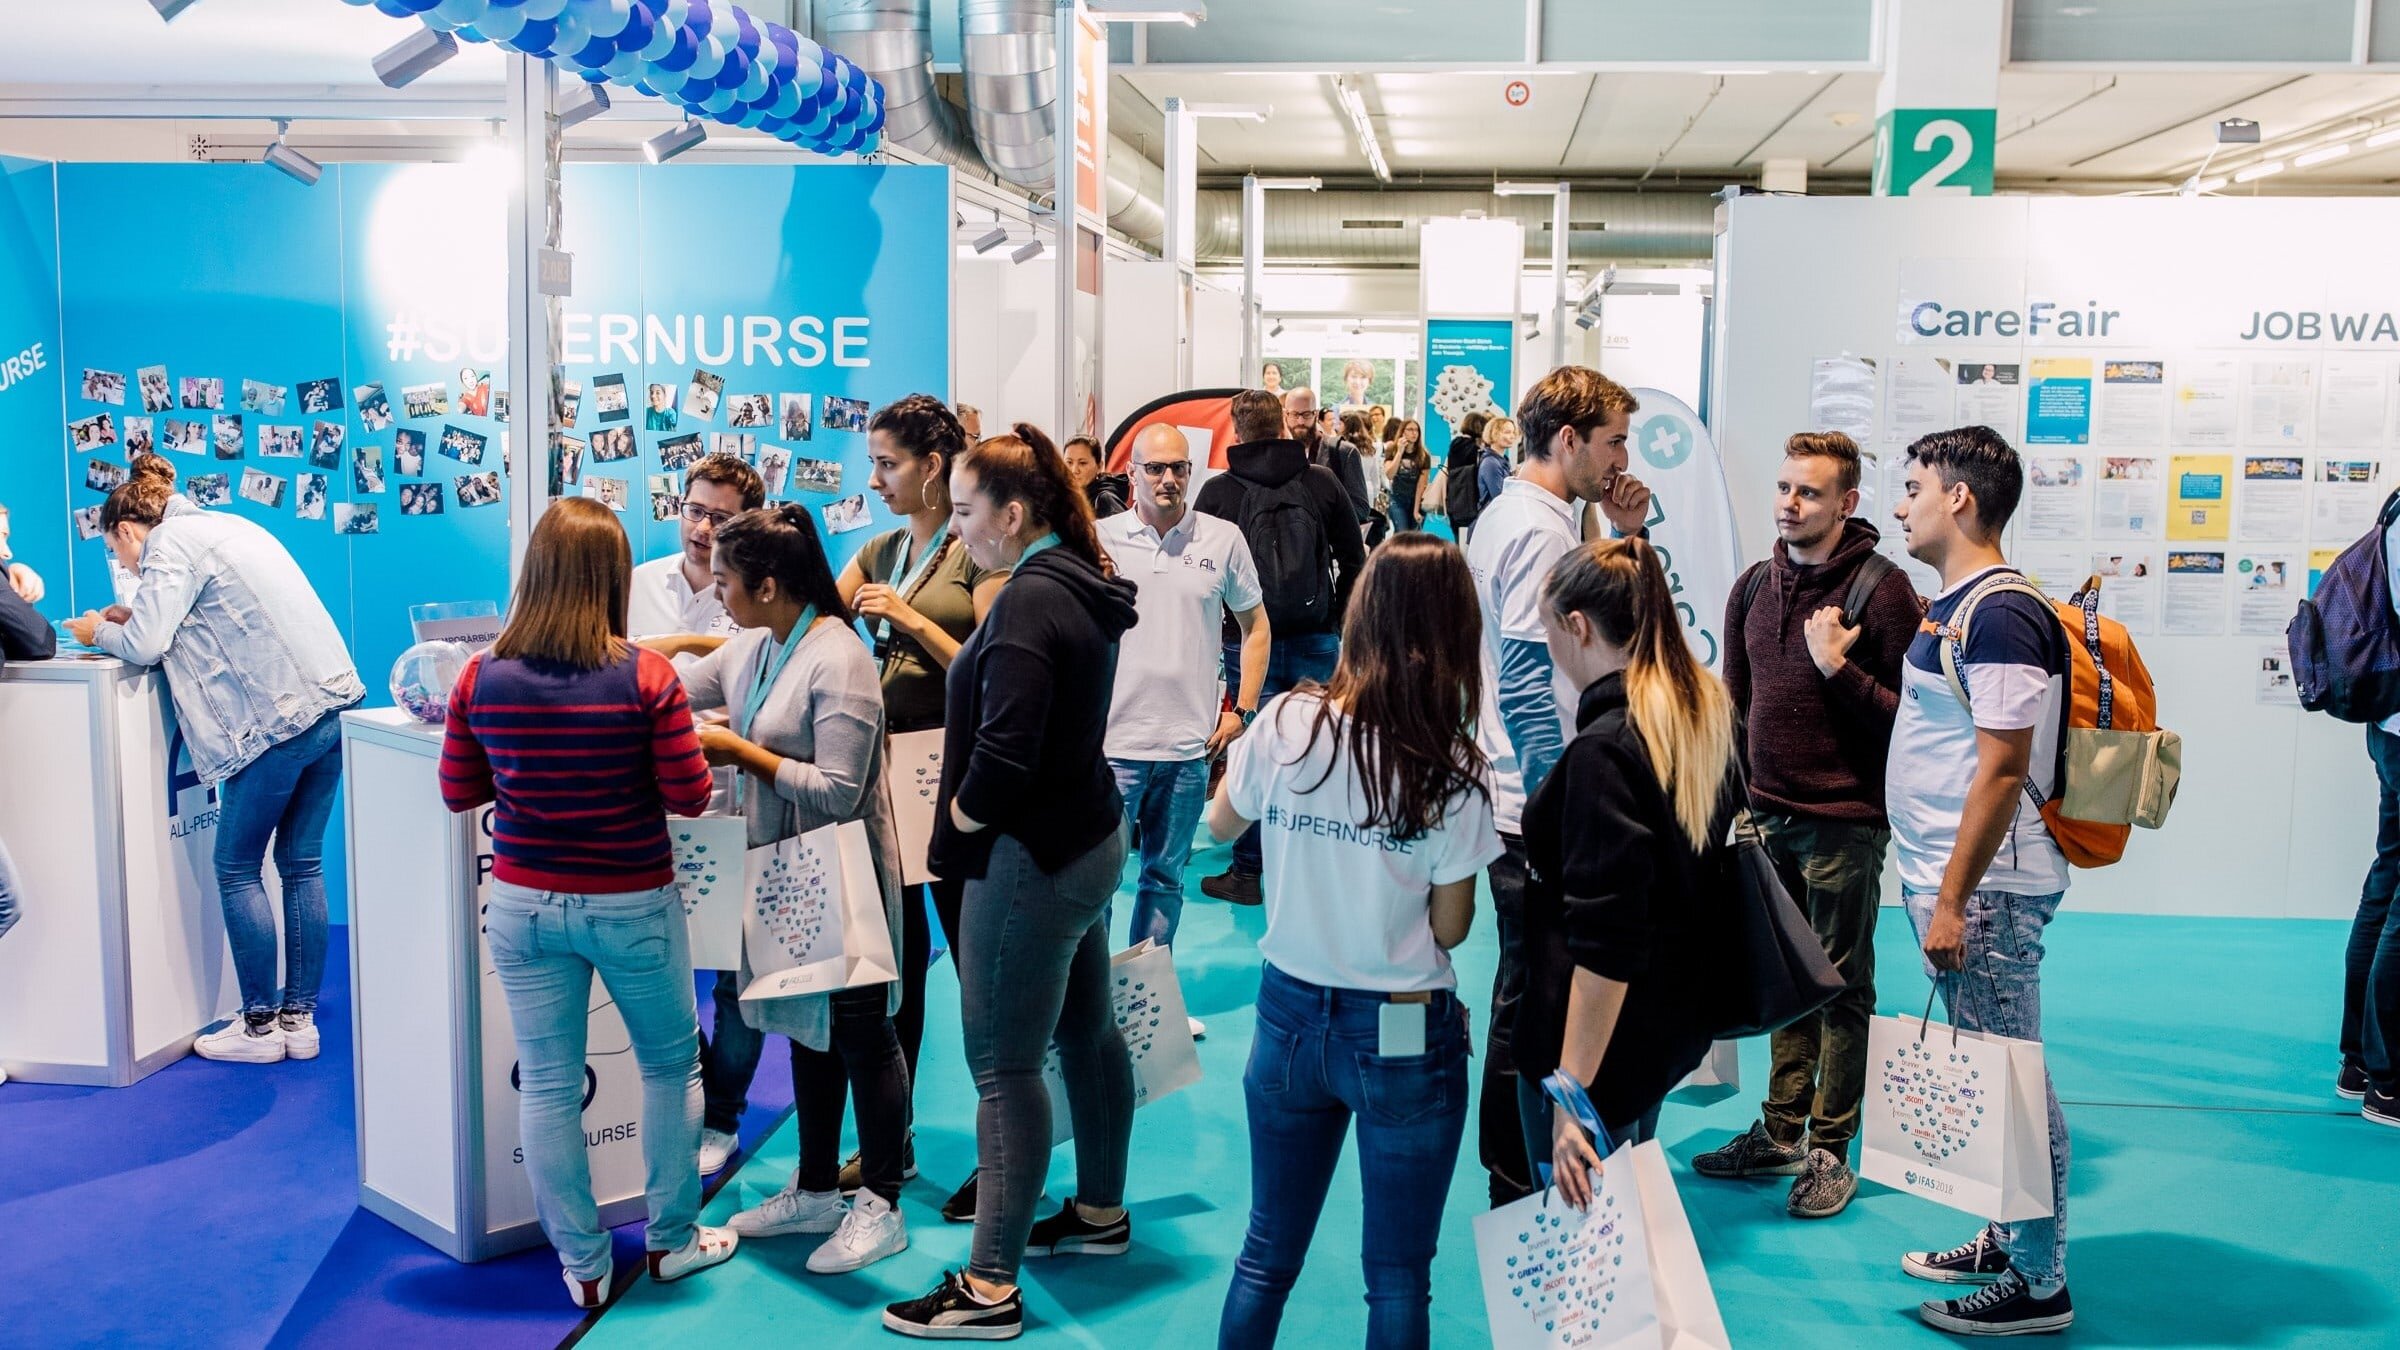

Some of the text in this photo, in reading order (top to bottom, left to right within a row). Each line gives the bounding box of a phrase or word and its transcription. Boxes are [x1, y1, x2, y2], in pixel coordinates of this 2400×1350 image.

[1907, 119, 1973, 196] 2
[387, 312, 870, 367] #SUERNURSE
[2240, 311, 2322, 341] JOB
[1918, 1175, 1954, 1195] IFAS 2018
